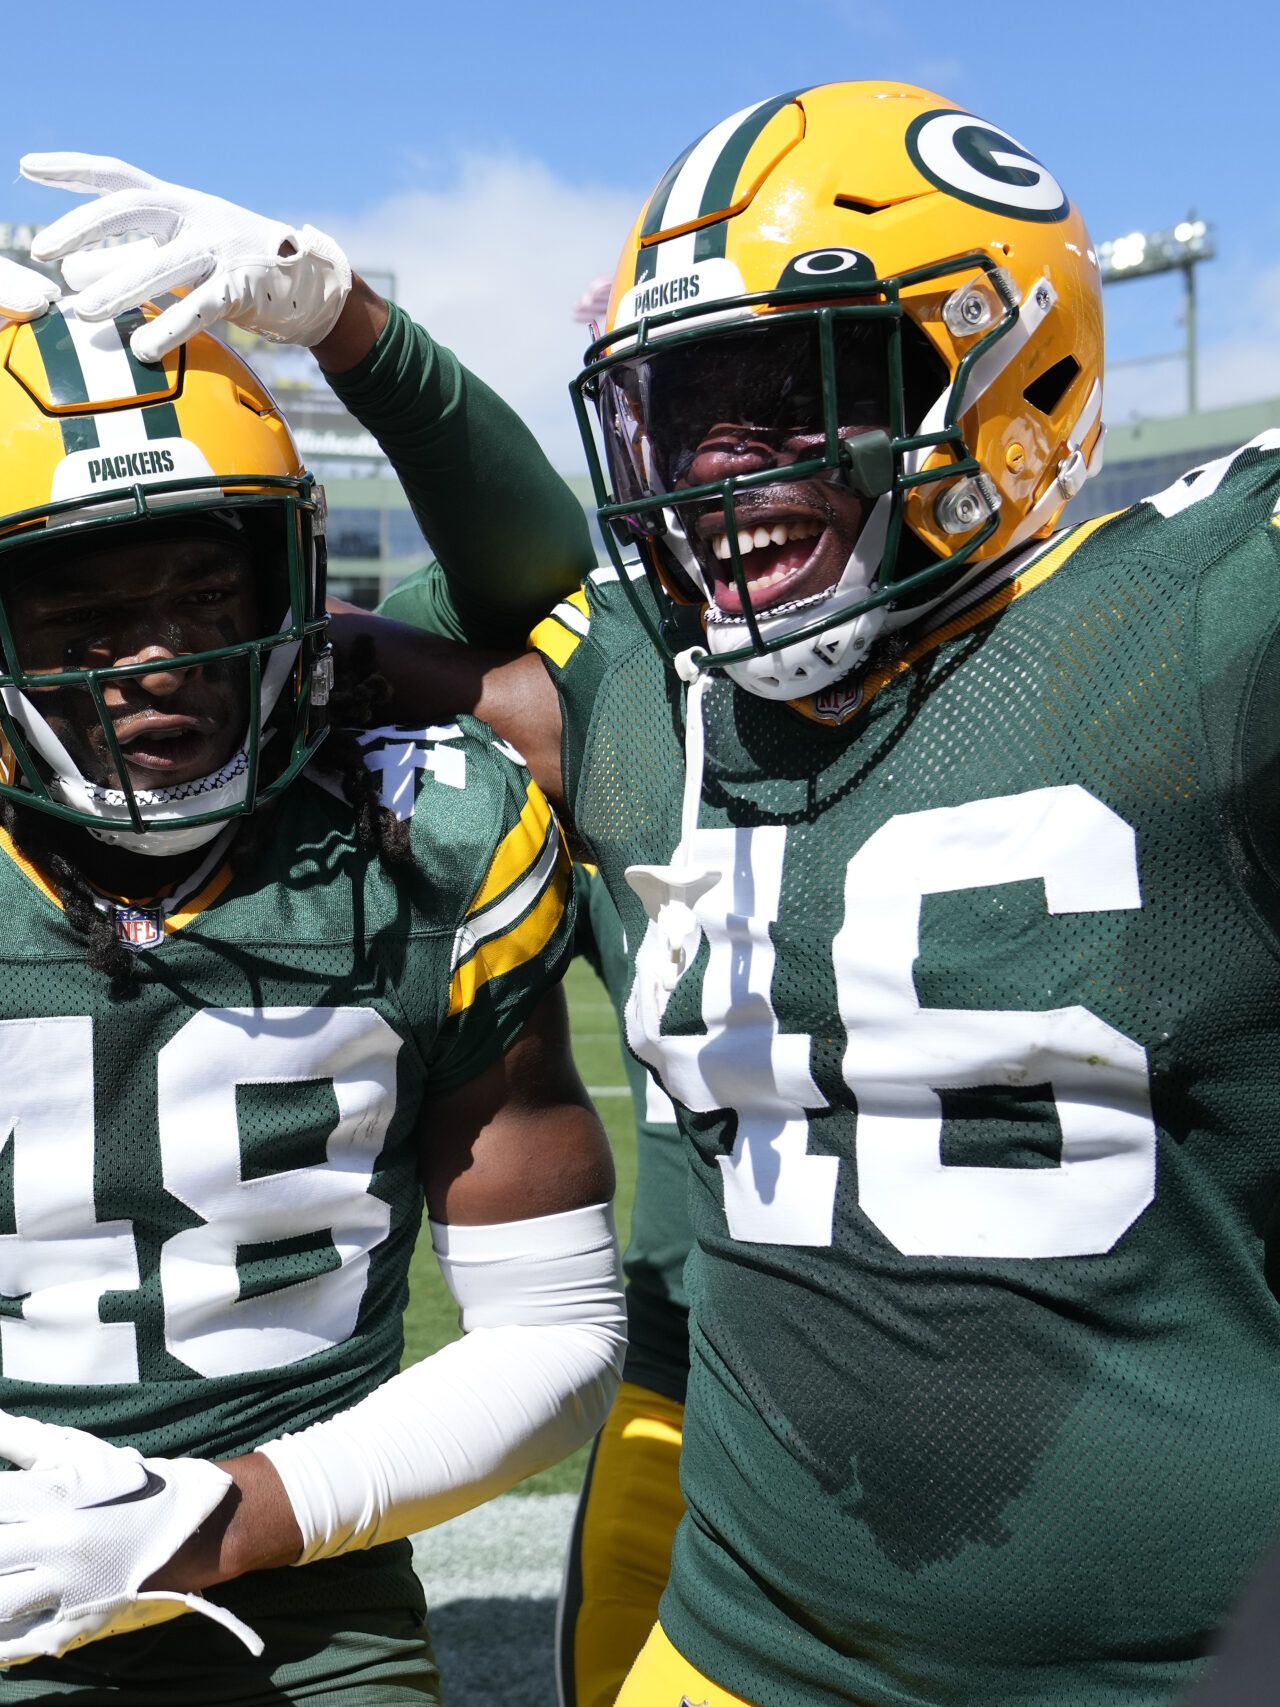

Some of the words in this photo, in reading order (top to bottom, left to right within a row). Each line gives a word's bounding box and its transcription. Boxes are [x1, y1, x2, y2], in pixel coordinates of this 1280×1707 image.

[635, 274, 700, 317] PACKERS
[87, 449, 175, 483] PACKERS
[118, 919, 156, 944] NFL
[625, 783, 1157, 1260] 46
